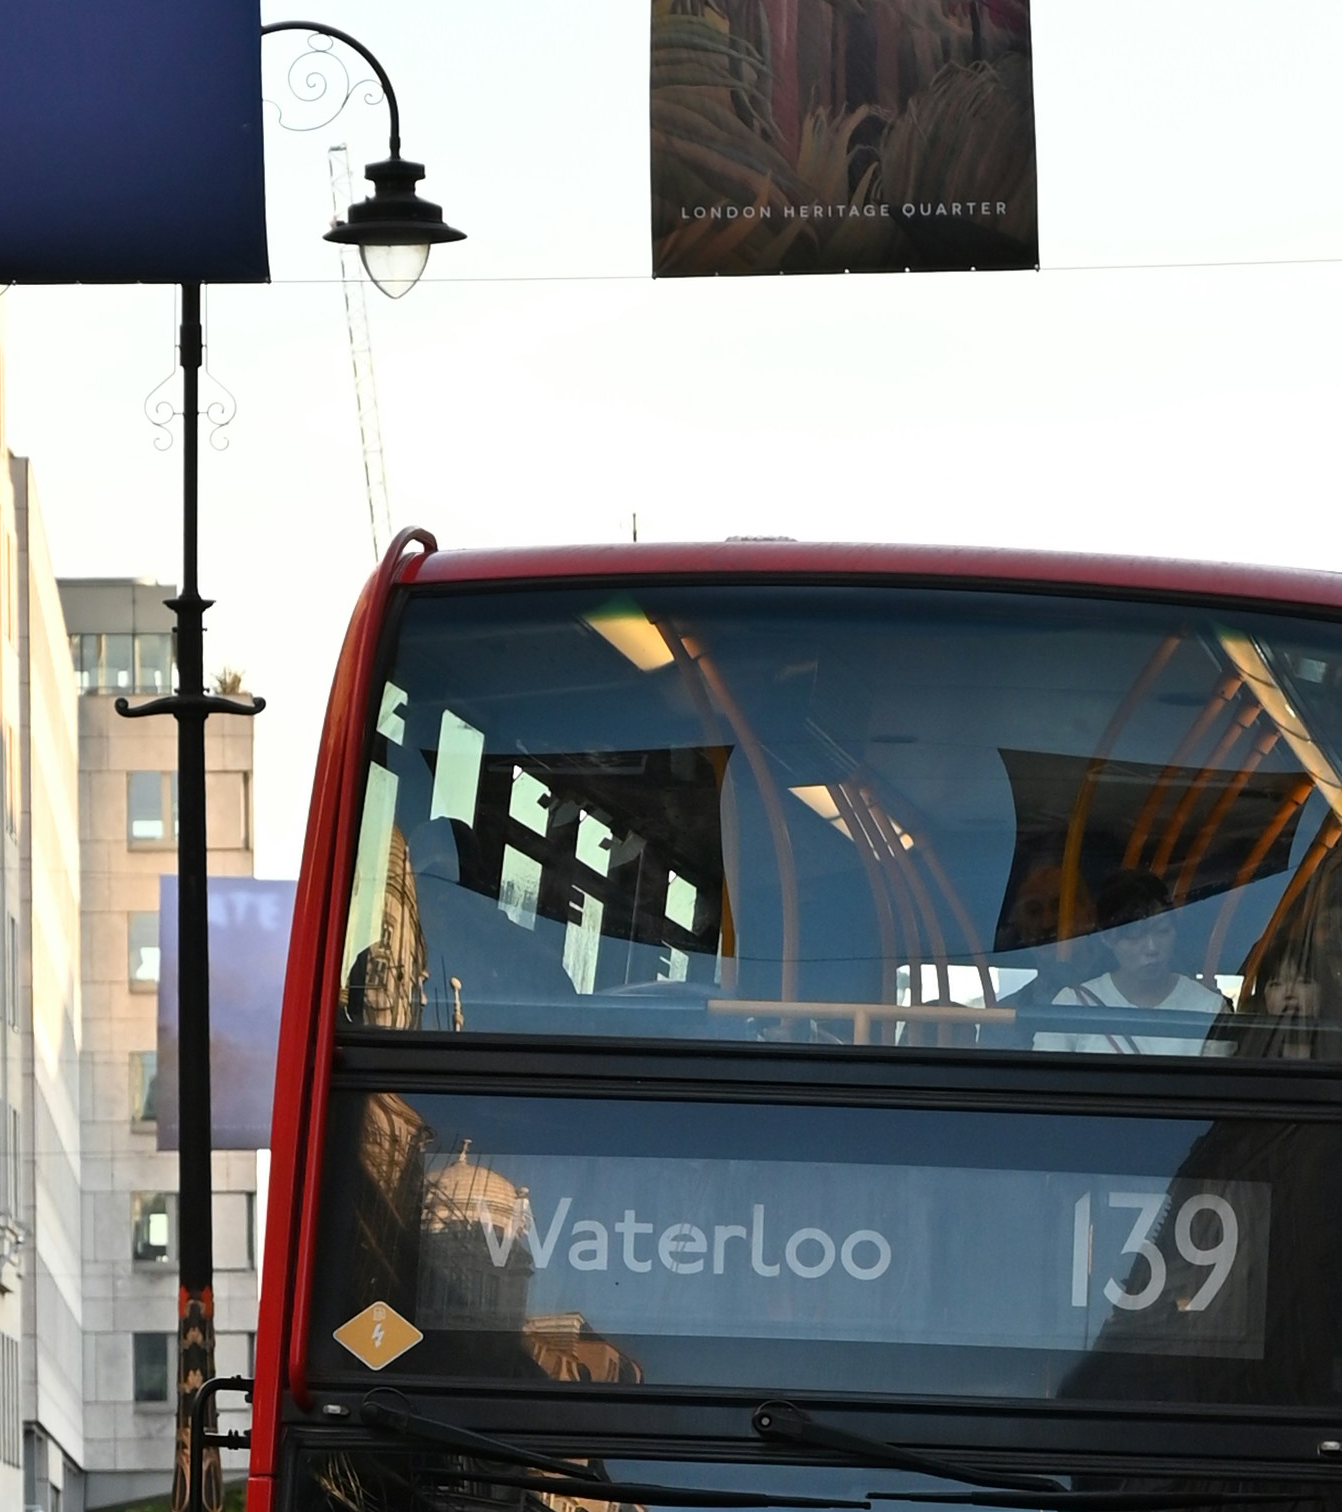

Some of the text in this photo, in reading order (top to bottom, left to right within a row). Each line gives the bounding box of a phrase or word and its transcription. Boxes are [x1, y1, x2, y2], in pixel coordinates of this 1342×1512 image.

[681, 200, 1008, 220] LONDON HERITAGE QUARTER
[481, 1191, 1240, 1315] Waterloo 139
